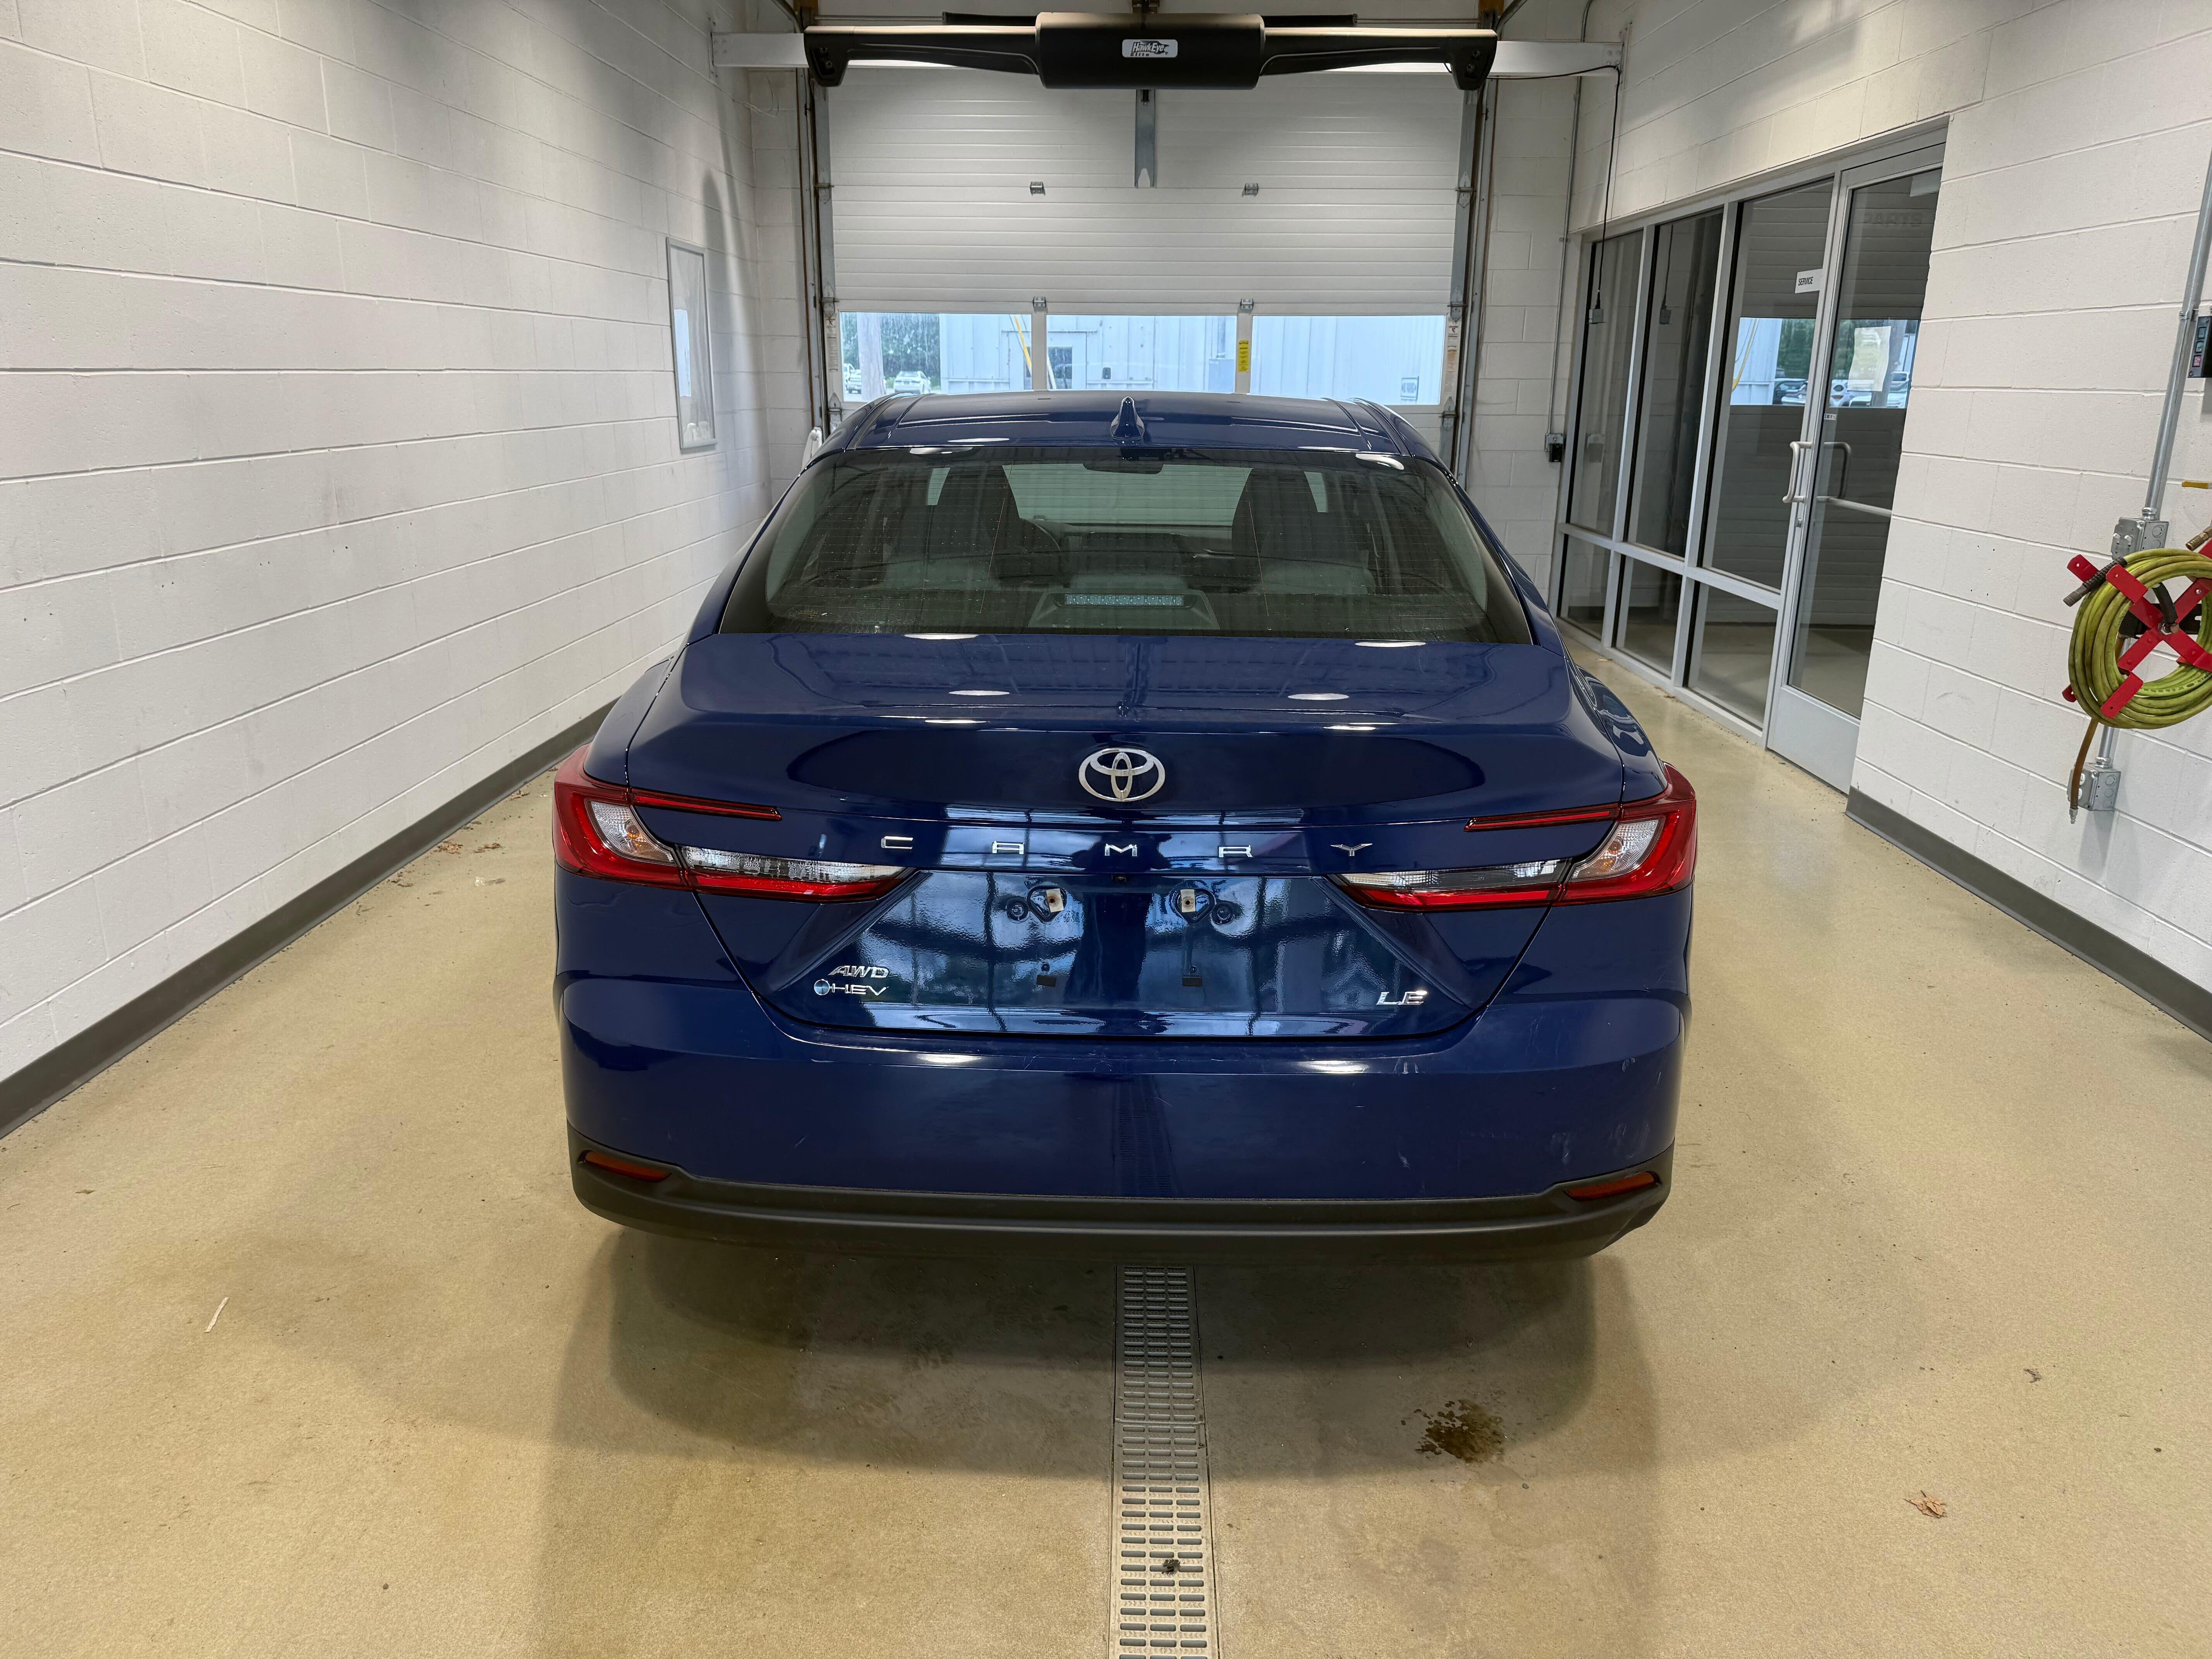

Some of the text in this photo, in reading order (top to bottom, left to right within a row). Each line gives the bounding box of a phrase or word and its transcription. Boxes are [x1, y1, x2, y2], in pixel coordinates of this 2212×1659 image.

[1132, 42, 1164, 53] HawkEye
[1798, 276, 1813, 286] SERVICE
[881, 836, 1373, 858] CAMRY
[828, 965, 890, 978] AWD
[830, 983, 889, 996] HEV
[1376, 990, 1427, 1005] LE
